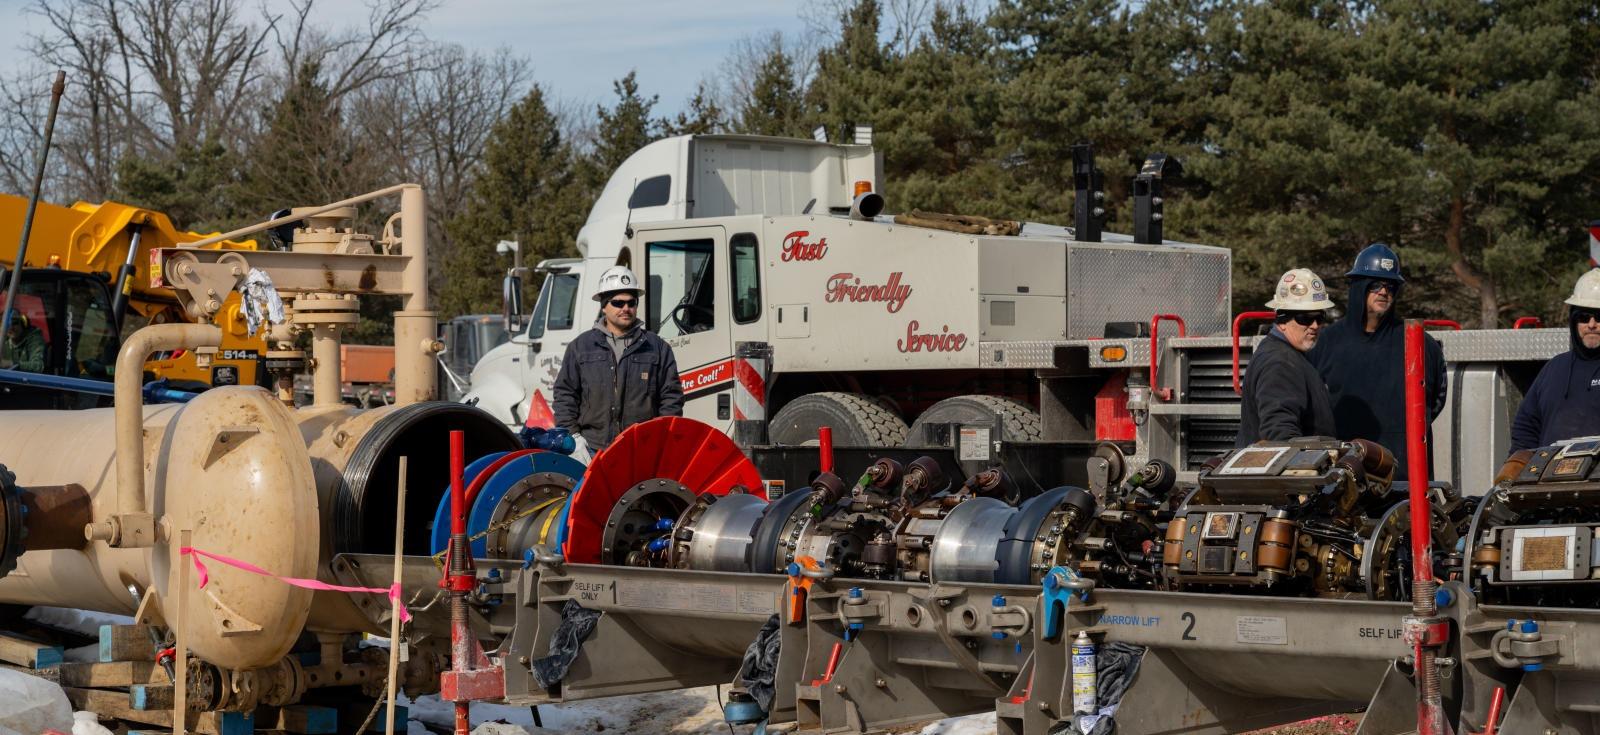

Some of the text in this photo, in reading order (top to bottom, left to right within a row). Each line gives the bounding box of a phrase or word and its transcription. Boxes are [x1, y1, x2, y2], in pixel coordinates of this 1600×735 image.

[781, 231, 829, 262] Fast
[825, 272, 912, 313] Friendly
[897, 320, 967, 353] Service
[575, 583, 604, 592] SELF LIFT
[581, 592, 599, 601] ONLY
[609, 580, 617, 605] 1
[1099, 615, 1160, 627] NARROW LIFT
[1181, 611, 1197, 640] 2
[1359, 627, 1404, 639] SELF LIF
